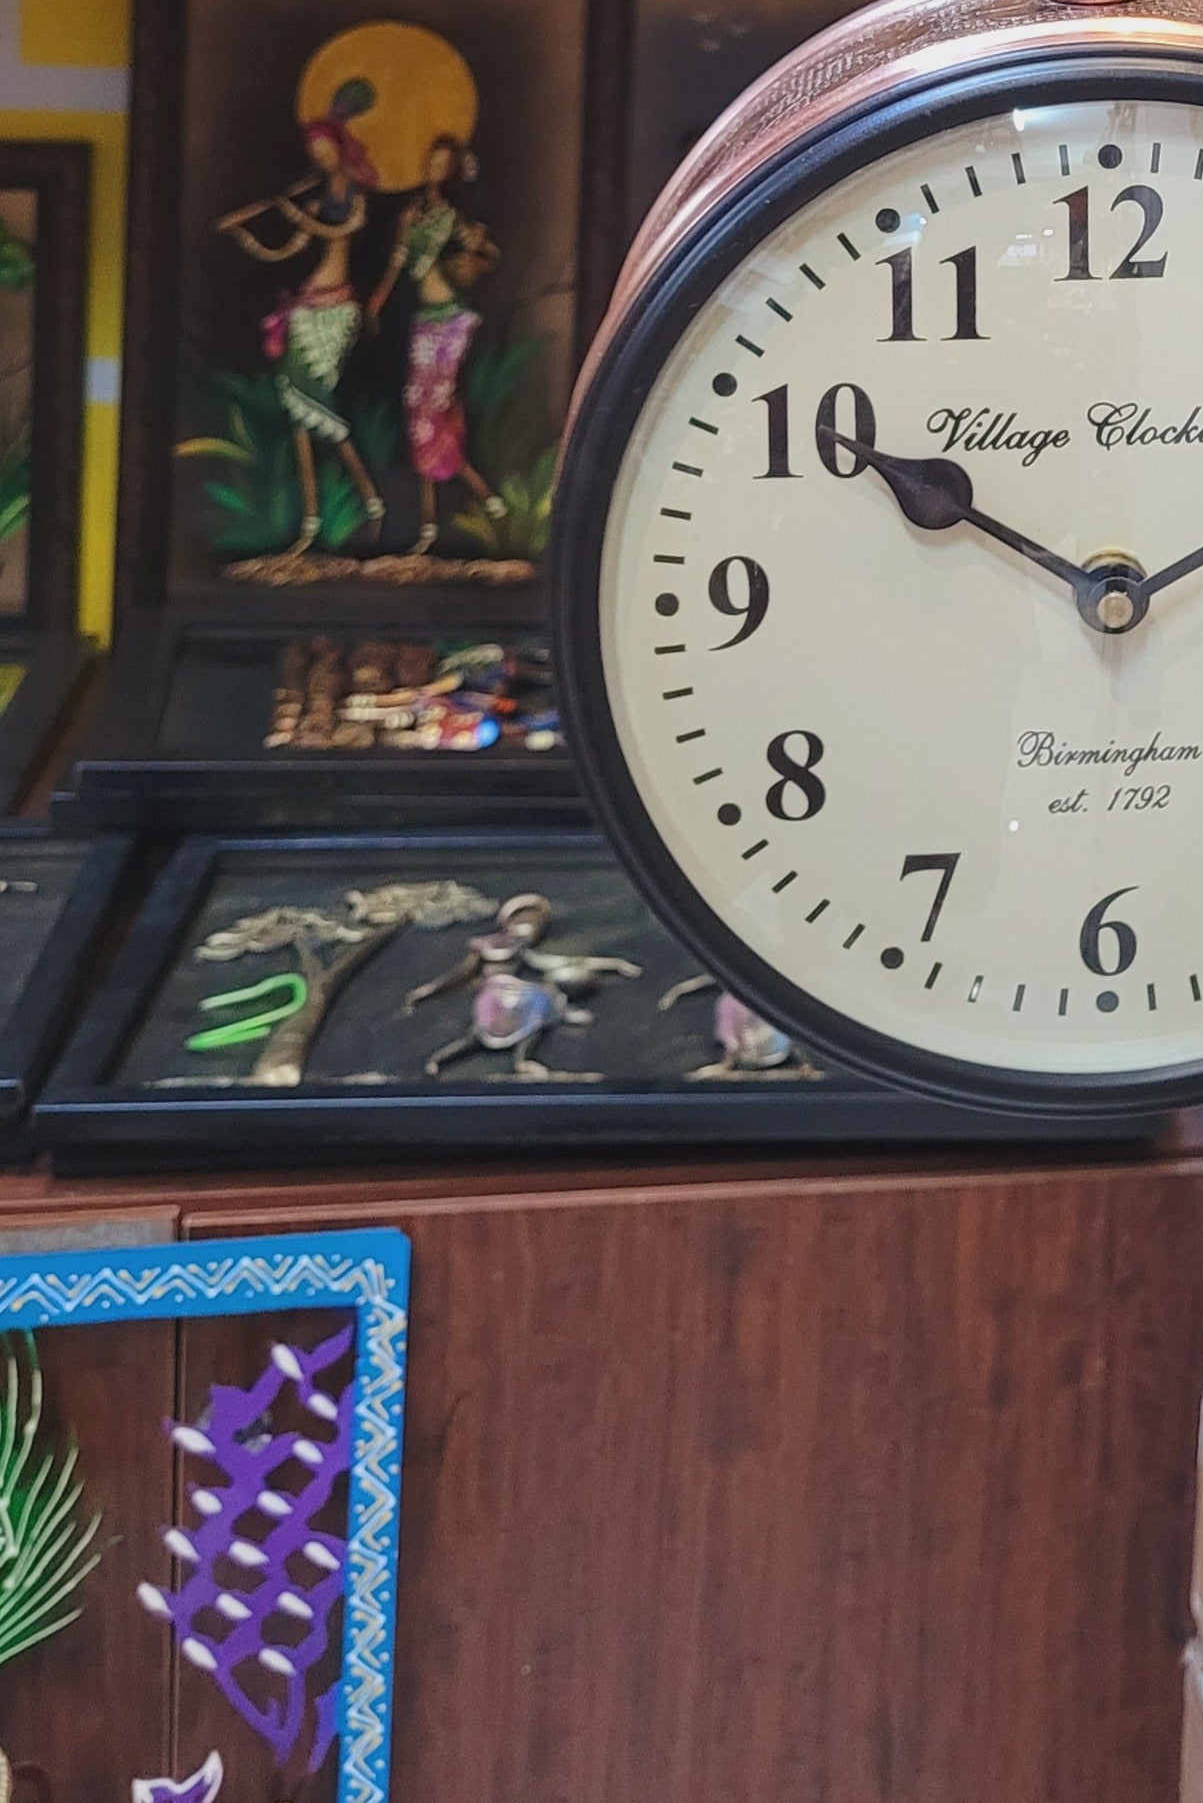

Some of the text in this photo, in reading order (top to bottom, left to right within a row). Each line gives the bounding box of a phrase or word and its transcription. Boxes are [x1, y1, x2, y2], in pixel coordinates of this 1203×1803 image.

[1053, 185, 1169, 282] 12
[874, 246, 991, 342] 11
[751, 382, 876, 480] 10
[926, 407, 1070, 468] Village
[707, 555, 770, 652] 9
[765, 729, 827, 822] 8
[1016, 730, 1202, 777] Birmingham
[1047, 784, 1171, 814] est. 1792
[899, 853, 961, 943] 7
[1079, 886, 1139, 977] 6
